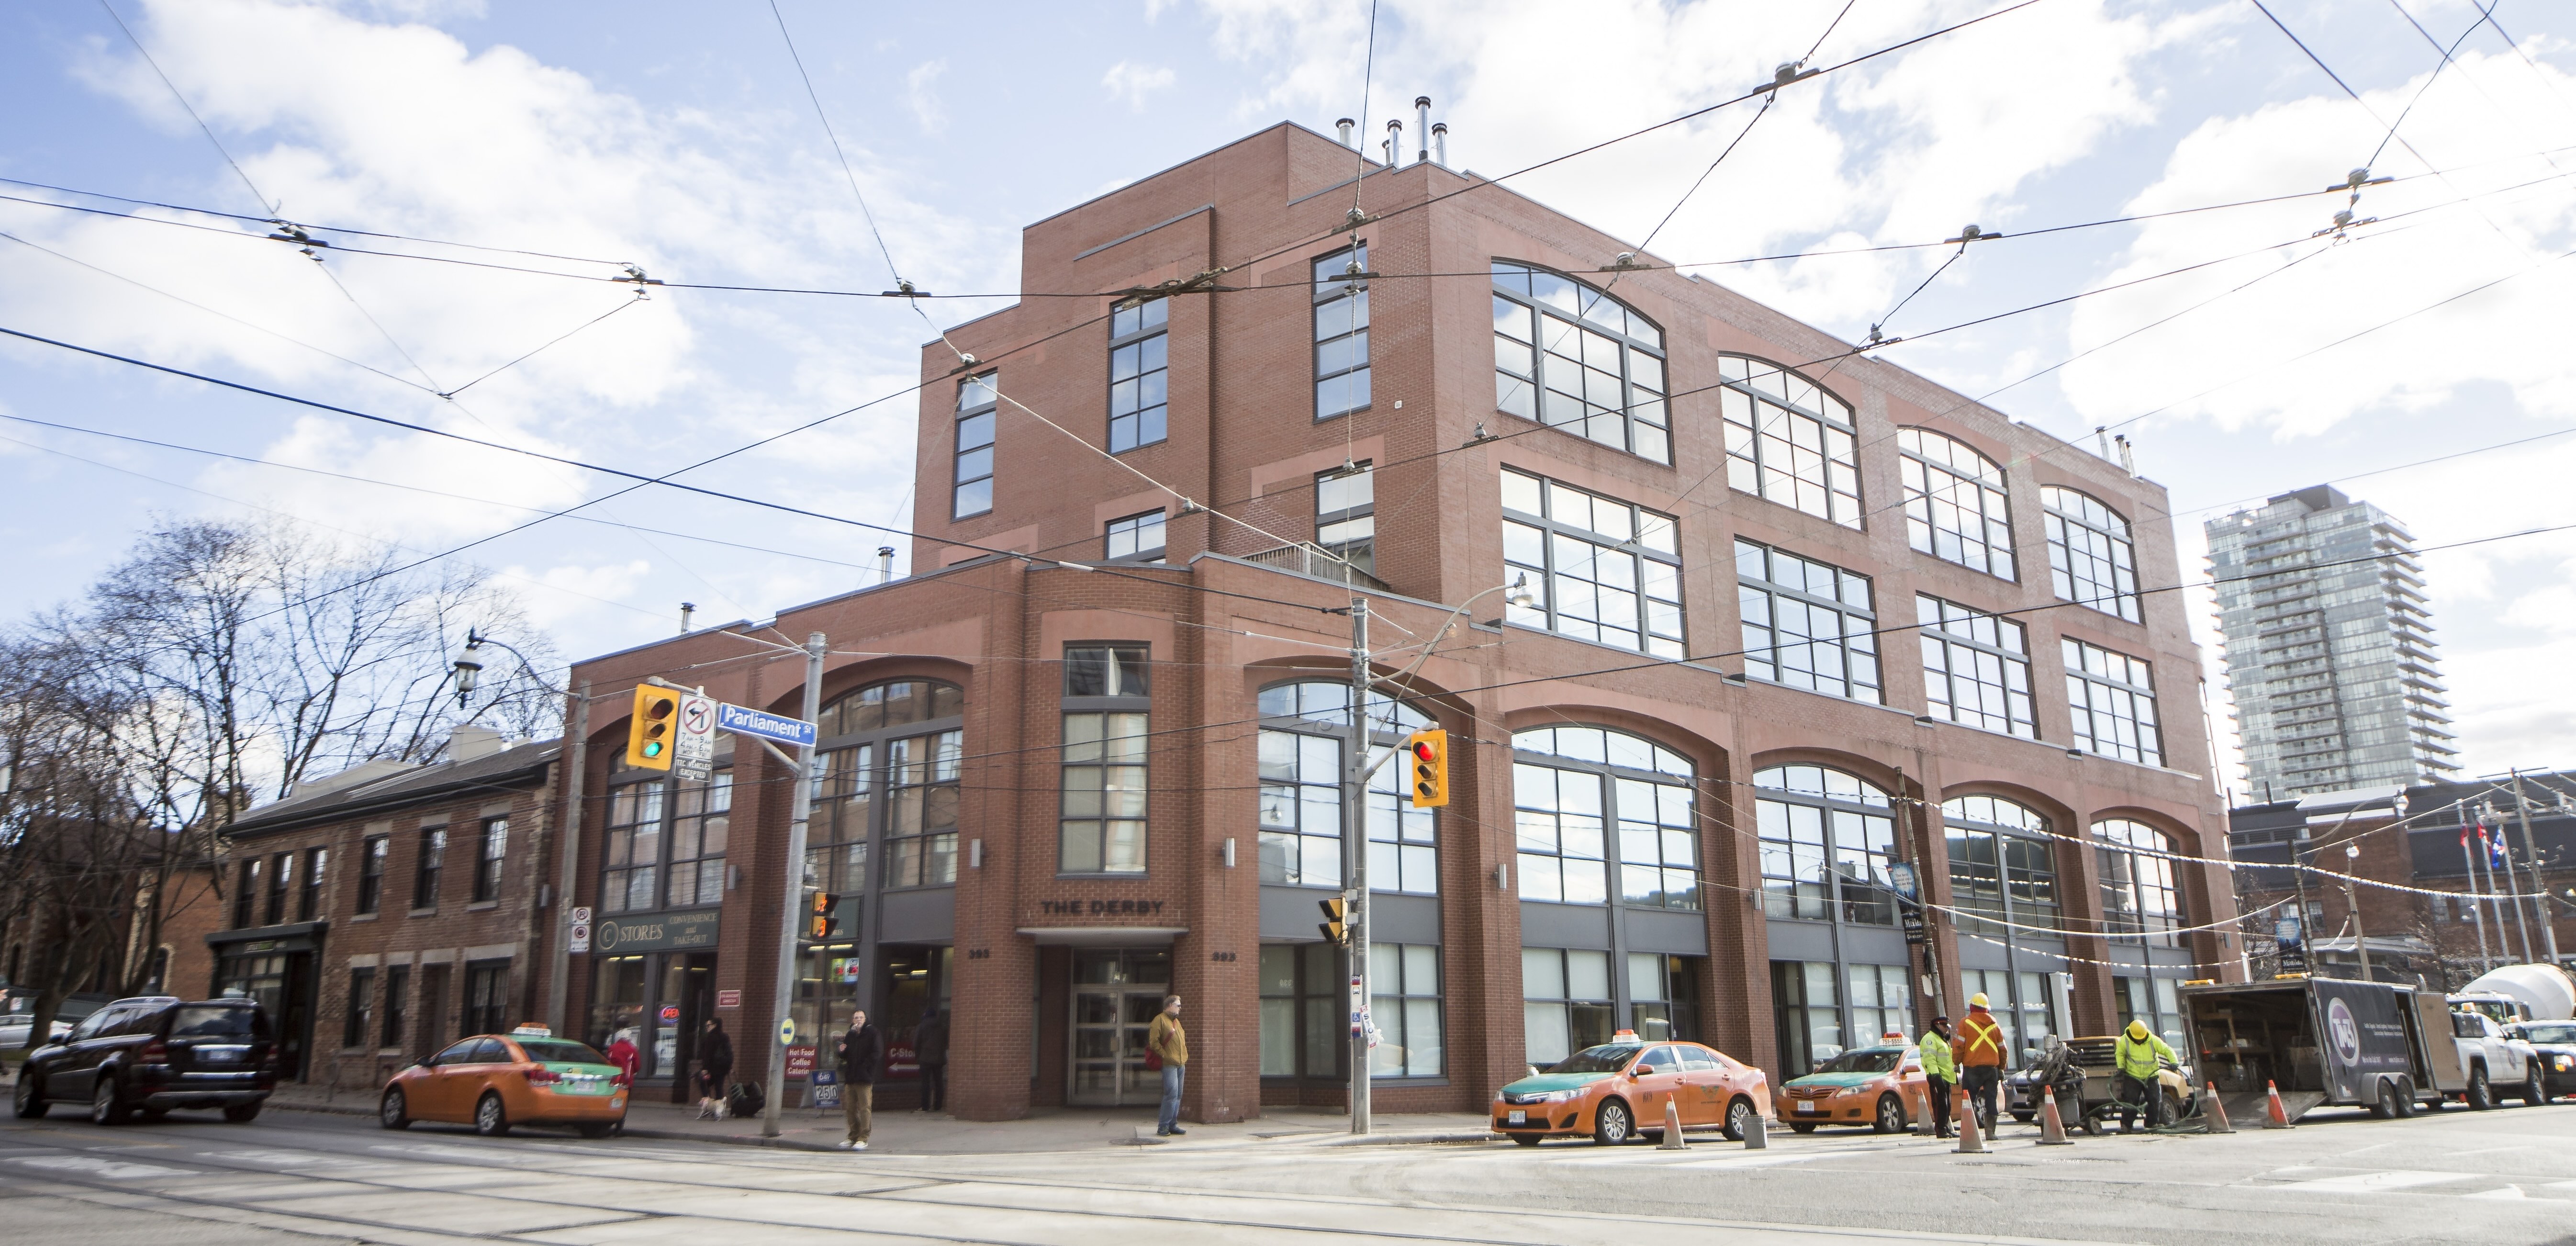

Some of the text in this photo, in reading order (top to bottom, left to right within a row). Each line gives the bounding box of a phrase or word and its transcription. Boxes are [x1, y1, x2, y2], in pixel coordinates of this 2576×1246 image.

[726, 705, 812, 738] Parliament St
[689, 761, 711, 770] VEHICLES
[680, 768, 706, 778] EXCEPTED
[1042, 900, 1164, 914] THE DERBY
[670, 912, 717, 924] CONVENIENCE
[620, 923, 664, 943] STORES
[674, 934, 708, 945] TAKE-OUT
